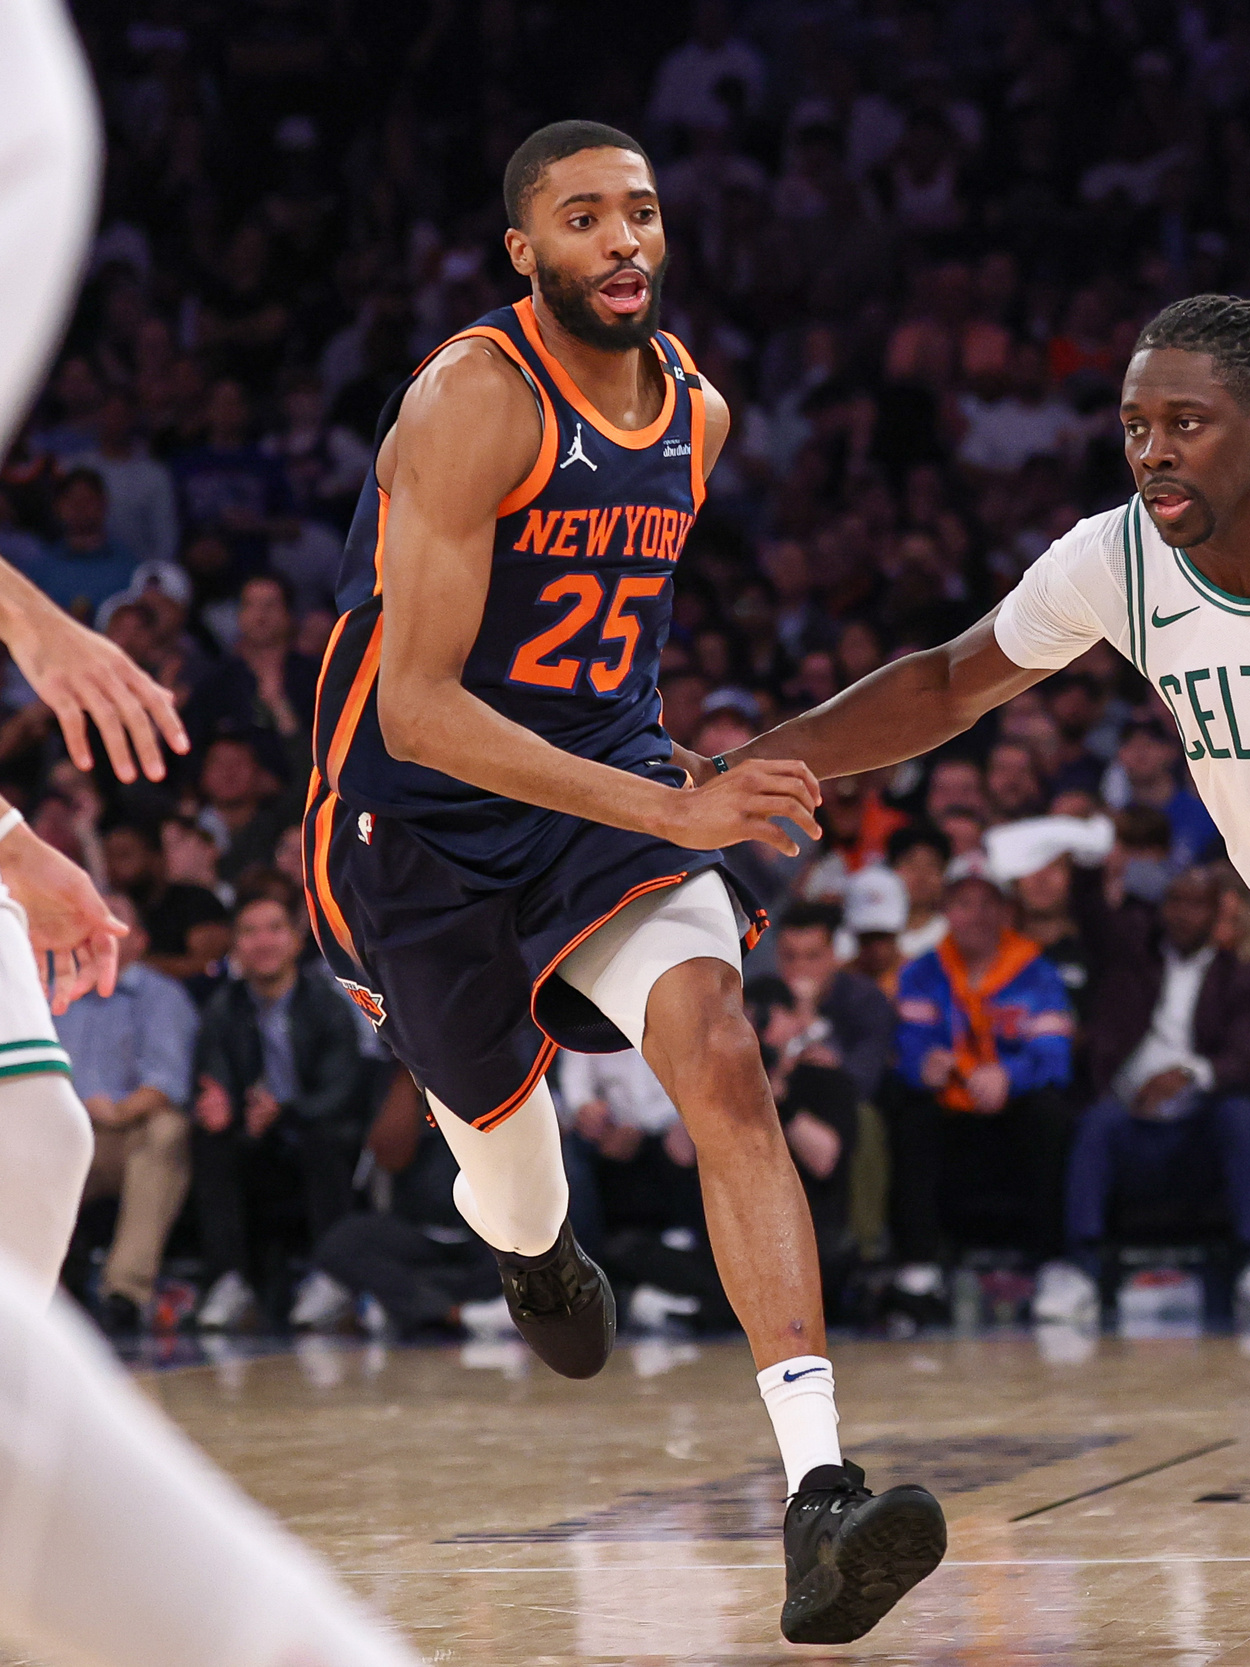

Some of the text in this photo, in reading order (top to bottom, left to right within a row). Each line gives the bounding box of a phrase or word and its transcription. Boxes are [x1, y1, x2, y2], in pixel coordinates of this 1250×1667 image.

[512, 505, 694, 562] NEW YORK
[506, 572, 668, 696] 25
